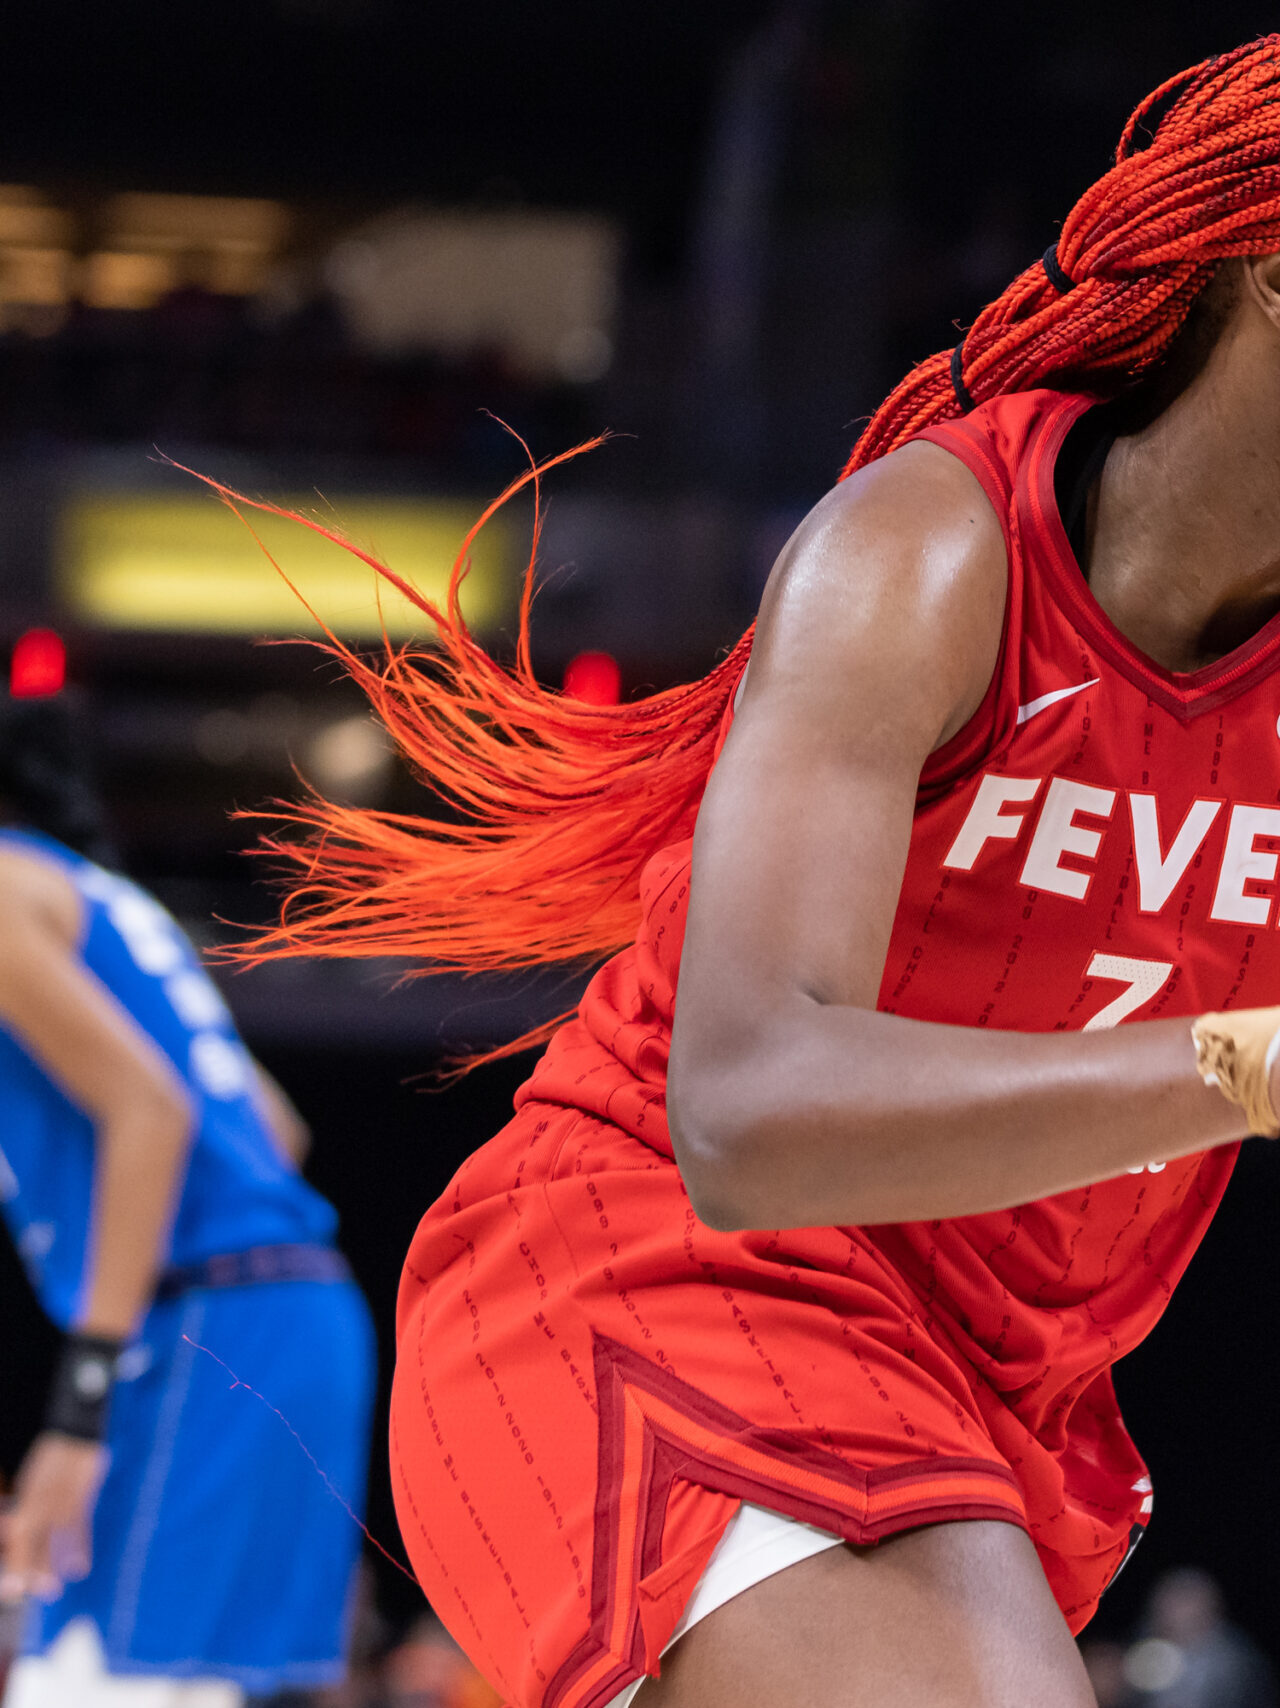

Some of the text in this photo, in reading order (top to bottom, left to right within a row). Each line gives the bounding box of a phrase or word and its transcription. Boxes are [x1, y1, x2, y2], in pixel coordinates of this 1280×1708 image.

[1143, 723, 1153, 756] ME
[1177, 884, 1196, 952] 2012
[993, 934, 1023, 994] 2012
[533, 1311, 556, 1340] ME
[619, 1289, 652, 1340] 2012
[721, 1290, 804, 1425] BASKETBALL
[475, 1352, 507, 1407] 2012
[505, 1412, 534, 1465] 2020
[536, 1475, 564, 1529] 1972
[460, 1489, 532, 1629] BASKETBALL
